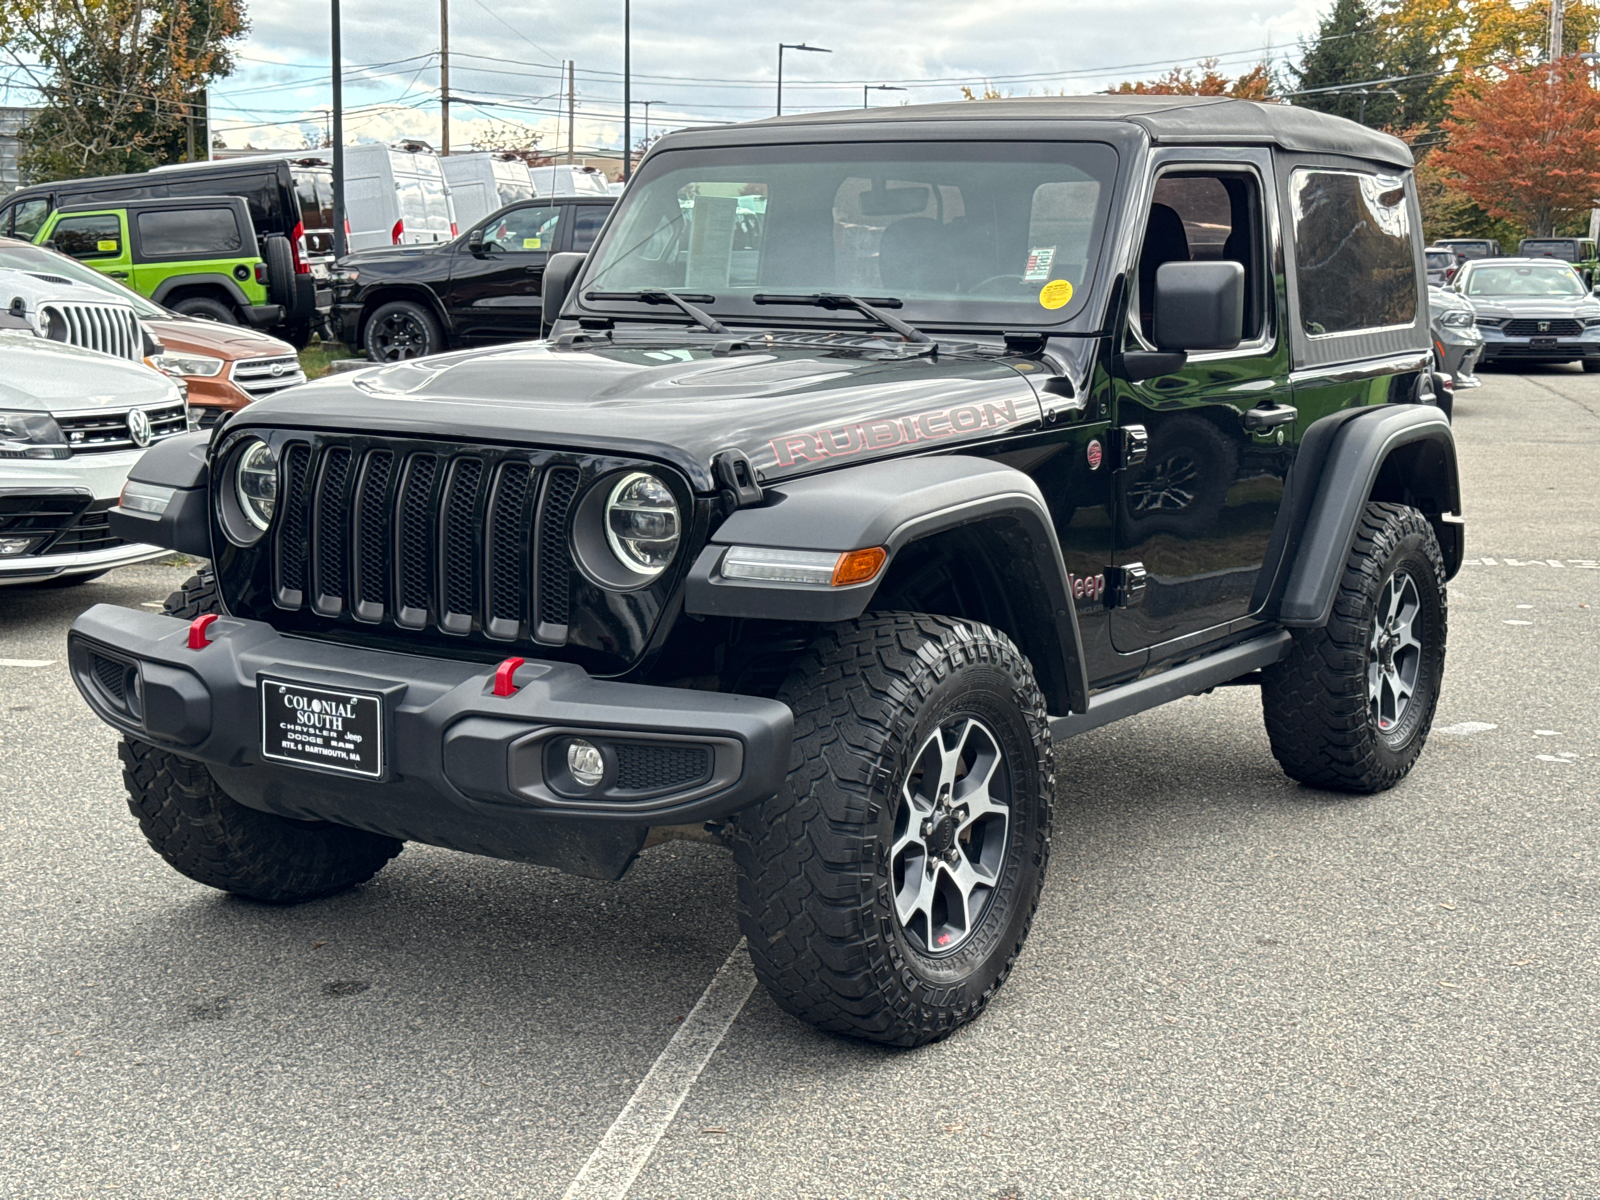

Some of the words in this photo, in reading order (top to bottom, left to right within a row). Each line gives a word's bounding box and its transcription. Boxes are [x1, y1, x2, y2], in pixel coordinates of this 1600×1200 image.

[769, 400, 1018, 467] RUBICON
[284, 695, 355, 718] COLONIAL
[297, 710, 343, 731] SOUTH
[280, 722, 337, 738] CHRYSLER
[344, 731, 362, 743] Jeep
[287, 732, 323, 744] DODGE
[331, 740, 354, 749] RAM
[282, 740, 297, 750] RTE.
[305, 745, 349, 760] DARTMOUTH,
[350, 753, 361, 761] MA
